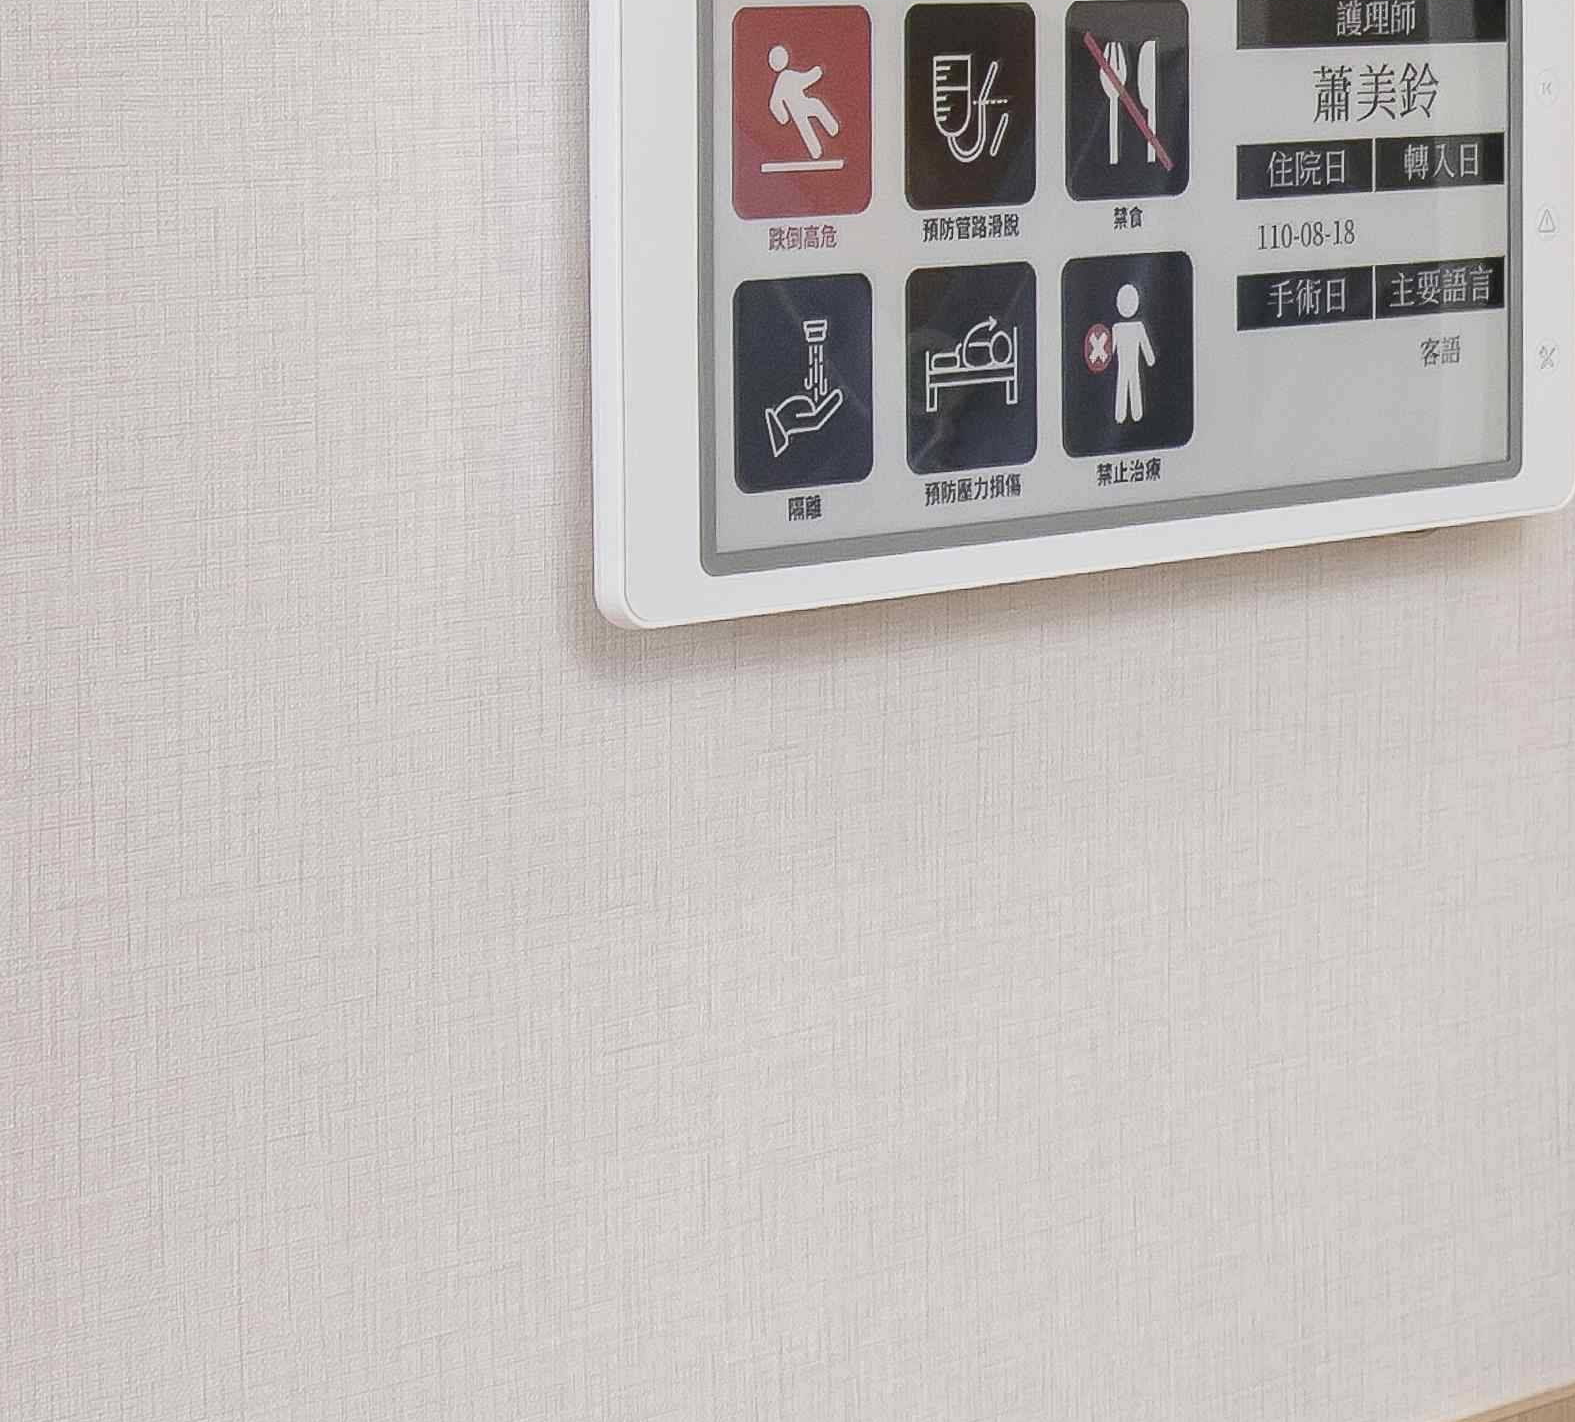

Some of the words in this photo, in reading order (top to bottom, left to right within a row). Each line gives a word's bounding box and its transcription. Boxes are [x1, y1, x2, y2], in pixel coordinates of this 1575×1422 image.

[1336, 0, 1417, 37] 護理師
[1312, 61, 1440, 124] 蕭美鈴
[1267, 149, 1346, 189] 住院日
[1403, 143, 1480, 182] 轉入日
[921, 212, 1021, 244] 預防管路滑脫
[1113, 205, 1144, 230] 禁食
[1256, 218, 1357, 251] 110-08-18
[768, 224, 840, 251] 跌倒高危
[1266, 277, 1347, 319] 手術日
[1389, 263, 1494, 309] 主要語言
[1420, 335, 1461, 369] 客語
[1095, 457, 1163, 487] 禁止治療
[924, 473, 1023, 507] 預防壓力損傷
[787, 494, 823, 522] 隔離
